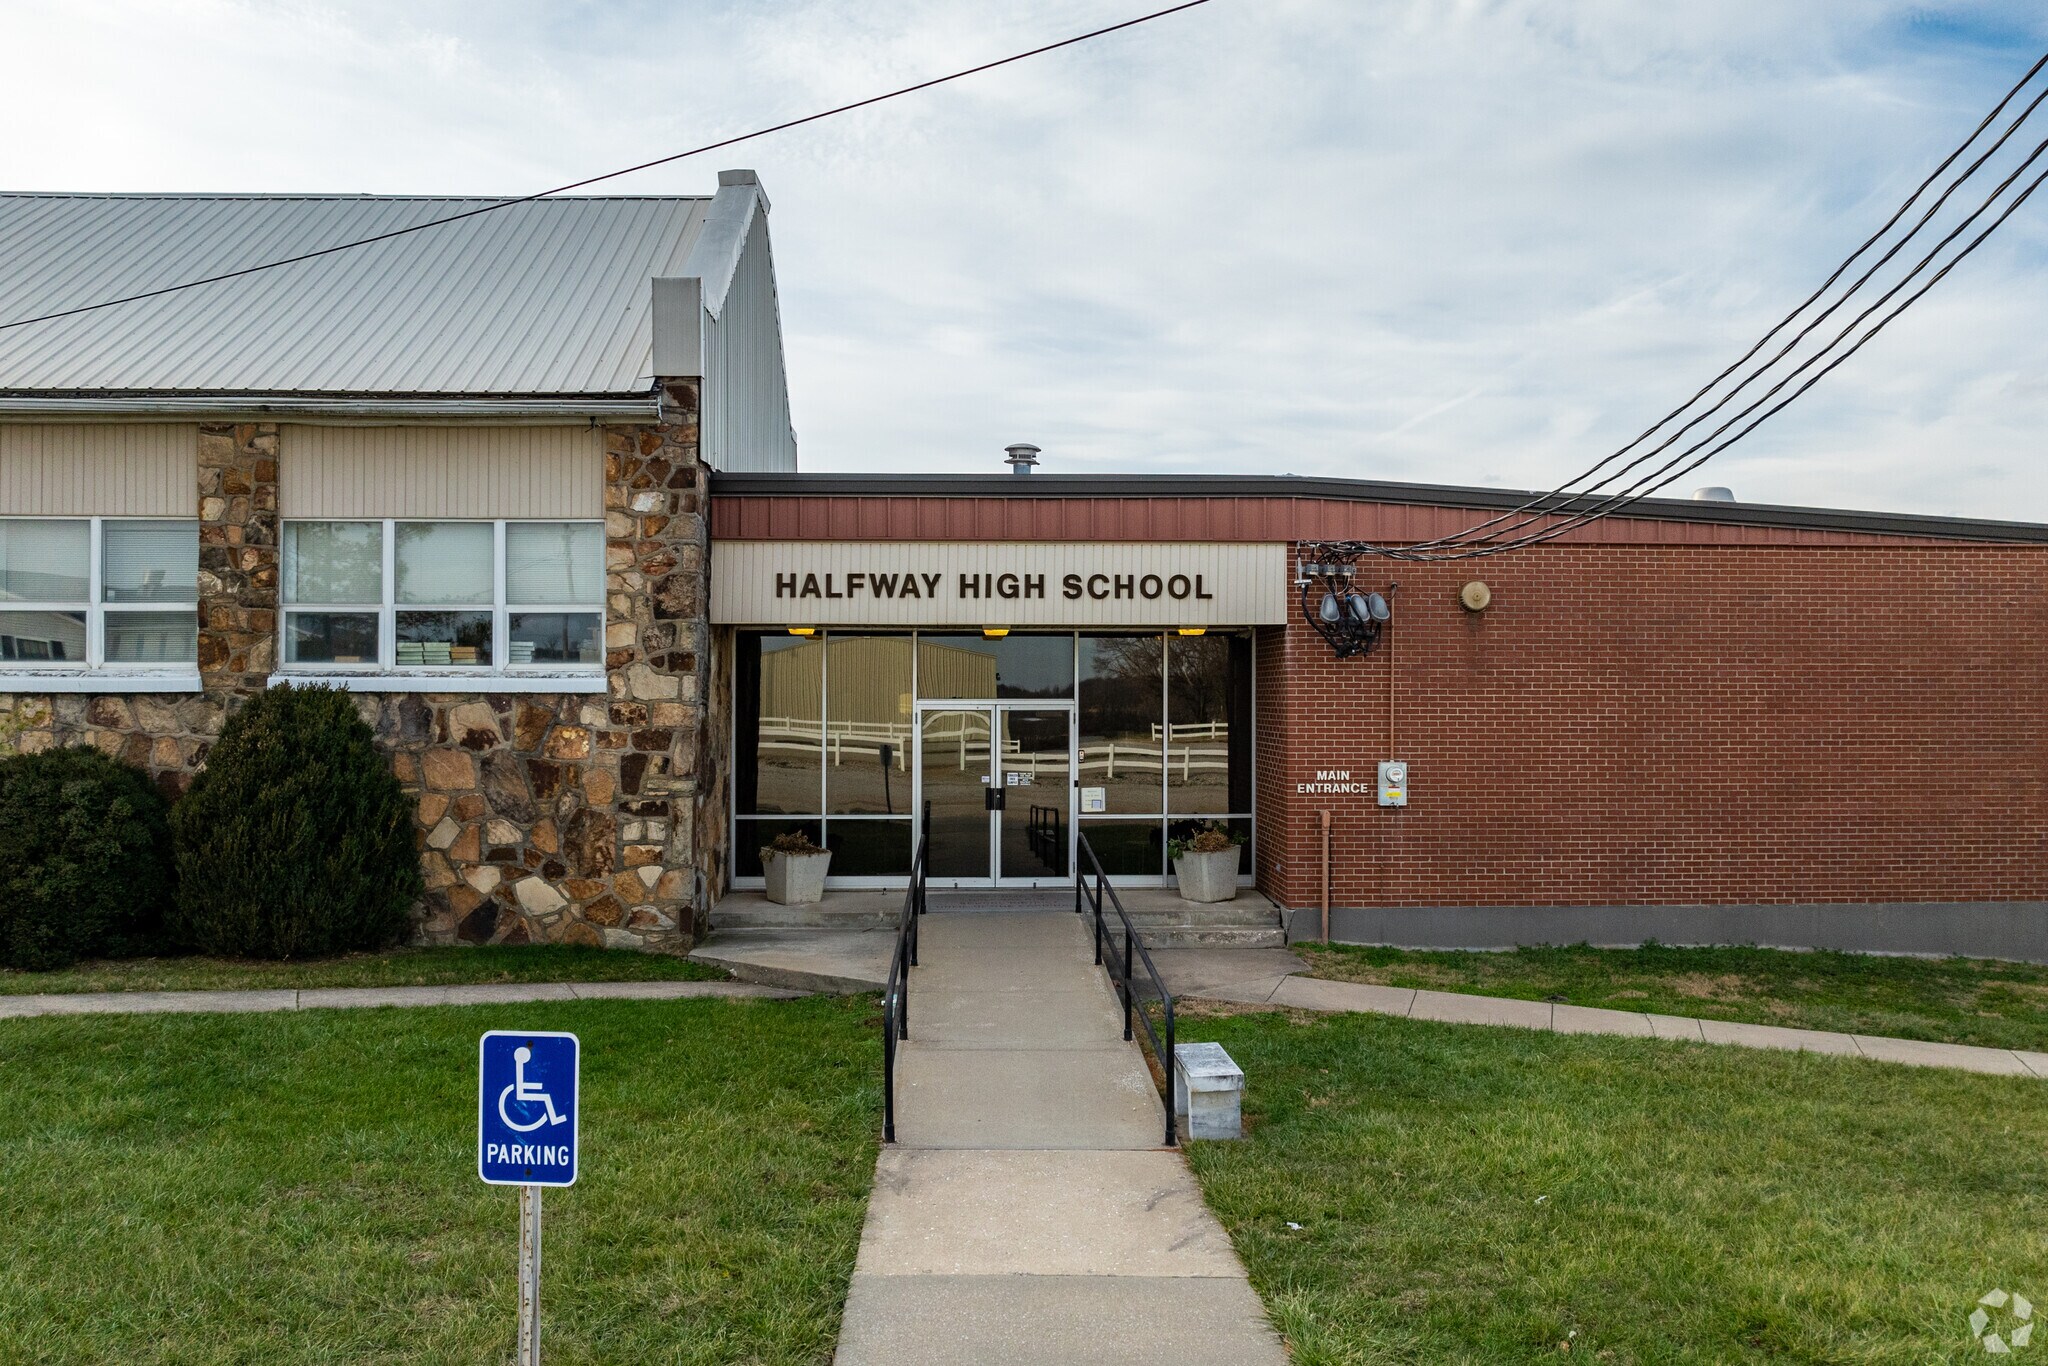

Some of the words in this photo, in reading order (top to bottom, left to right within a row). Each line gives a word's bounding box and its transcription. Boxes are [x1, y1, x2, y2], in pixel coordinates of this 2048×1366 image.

[776, 573, 942, 598] HALFWAY
[959, 573, 1045, 599] HIGH
[1062, 574, 1213, 600] SCHOOL
[1316, 770, 1350, 781] MAIN
[1297, 783, 1369, 793] ENTRANCE
[487, 1143, 569, 1166] PARKING
